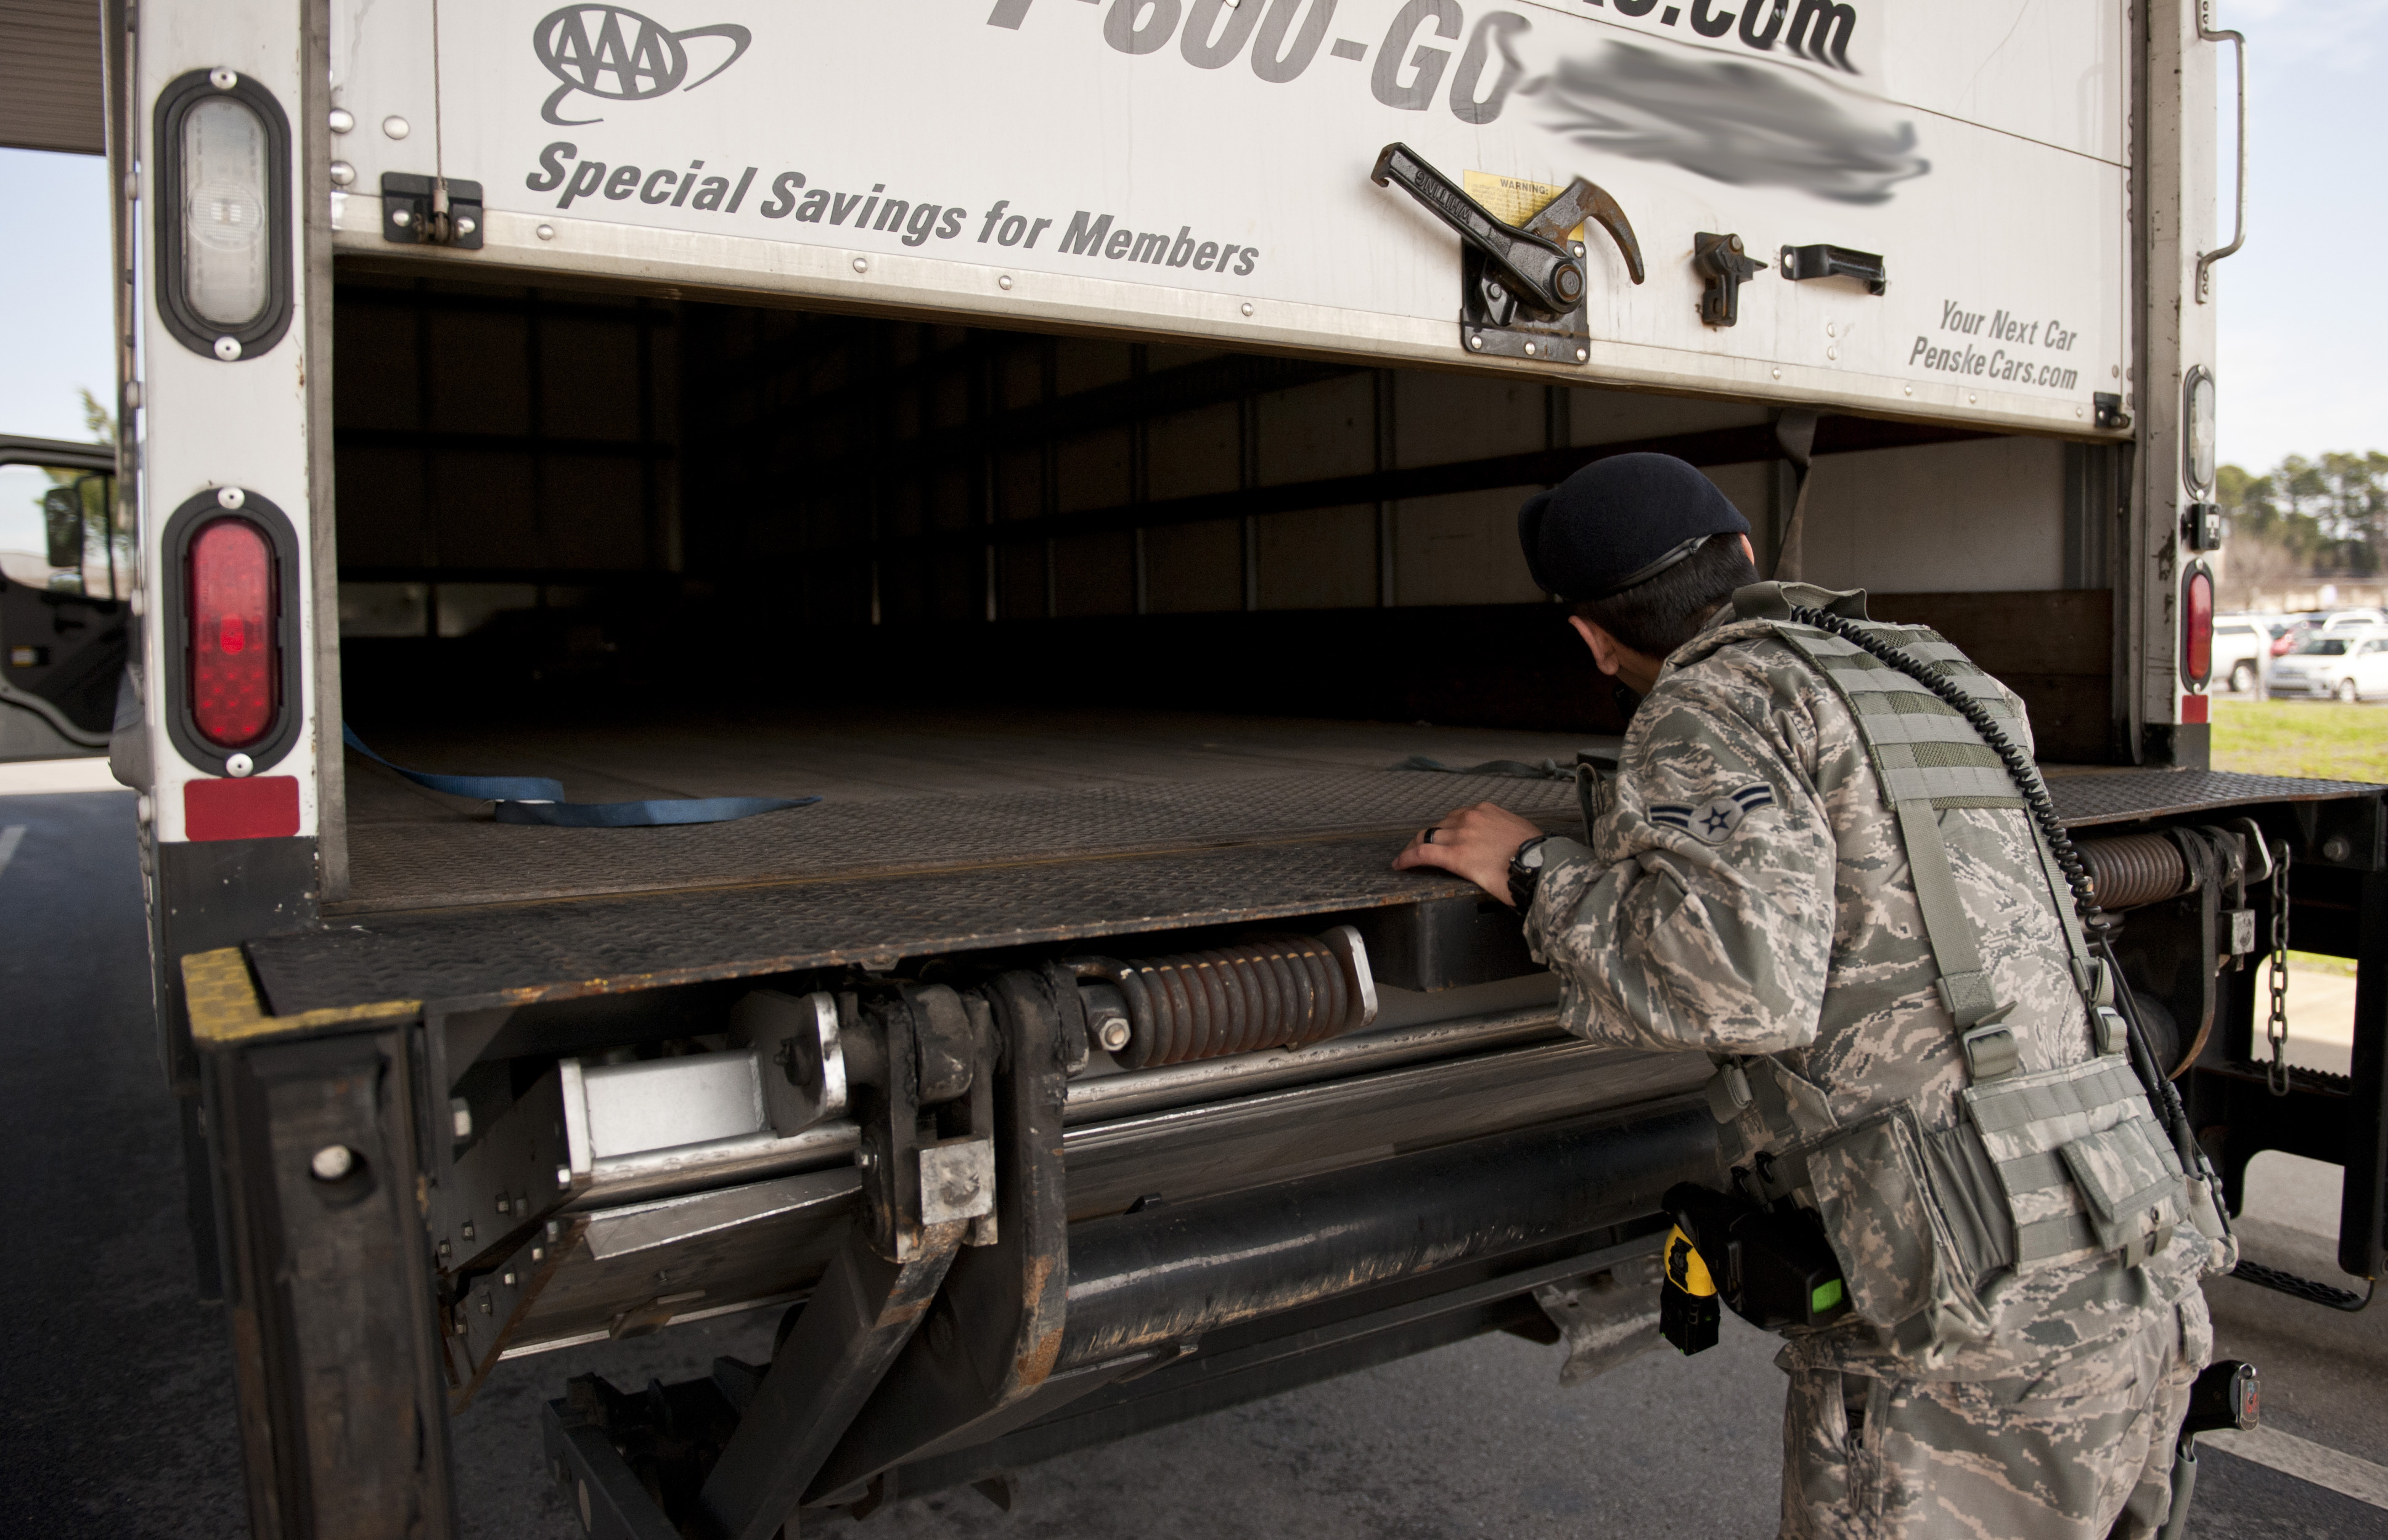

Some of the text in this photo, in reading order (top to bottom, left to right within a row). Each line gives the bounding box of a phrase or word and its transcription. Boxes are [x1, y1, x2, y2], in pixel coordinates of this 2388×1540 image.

[546, 5, 682, 100] AAA
[1583, 0, 1860, 75] .com
[526, 142, 1259, 276] Special Savings for Members
[1414, 169, 1473, 224] WHITING
[1500, 178, 1549, 195] WARNING:
[1940, 299, 2077, 351] Your Next Car
[1908, 336, 2078, 390] PenskeCars.com
